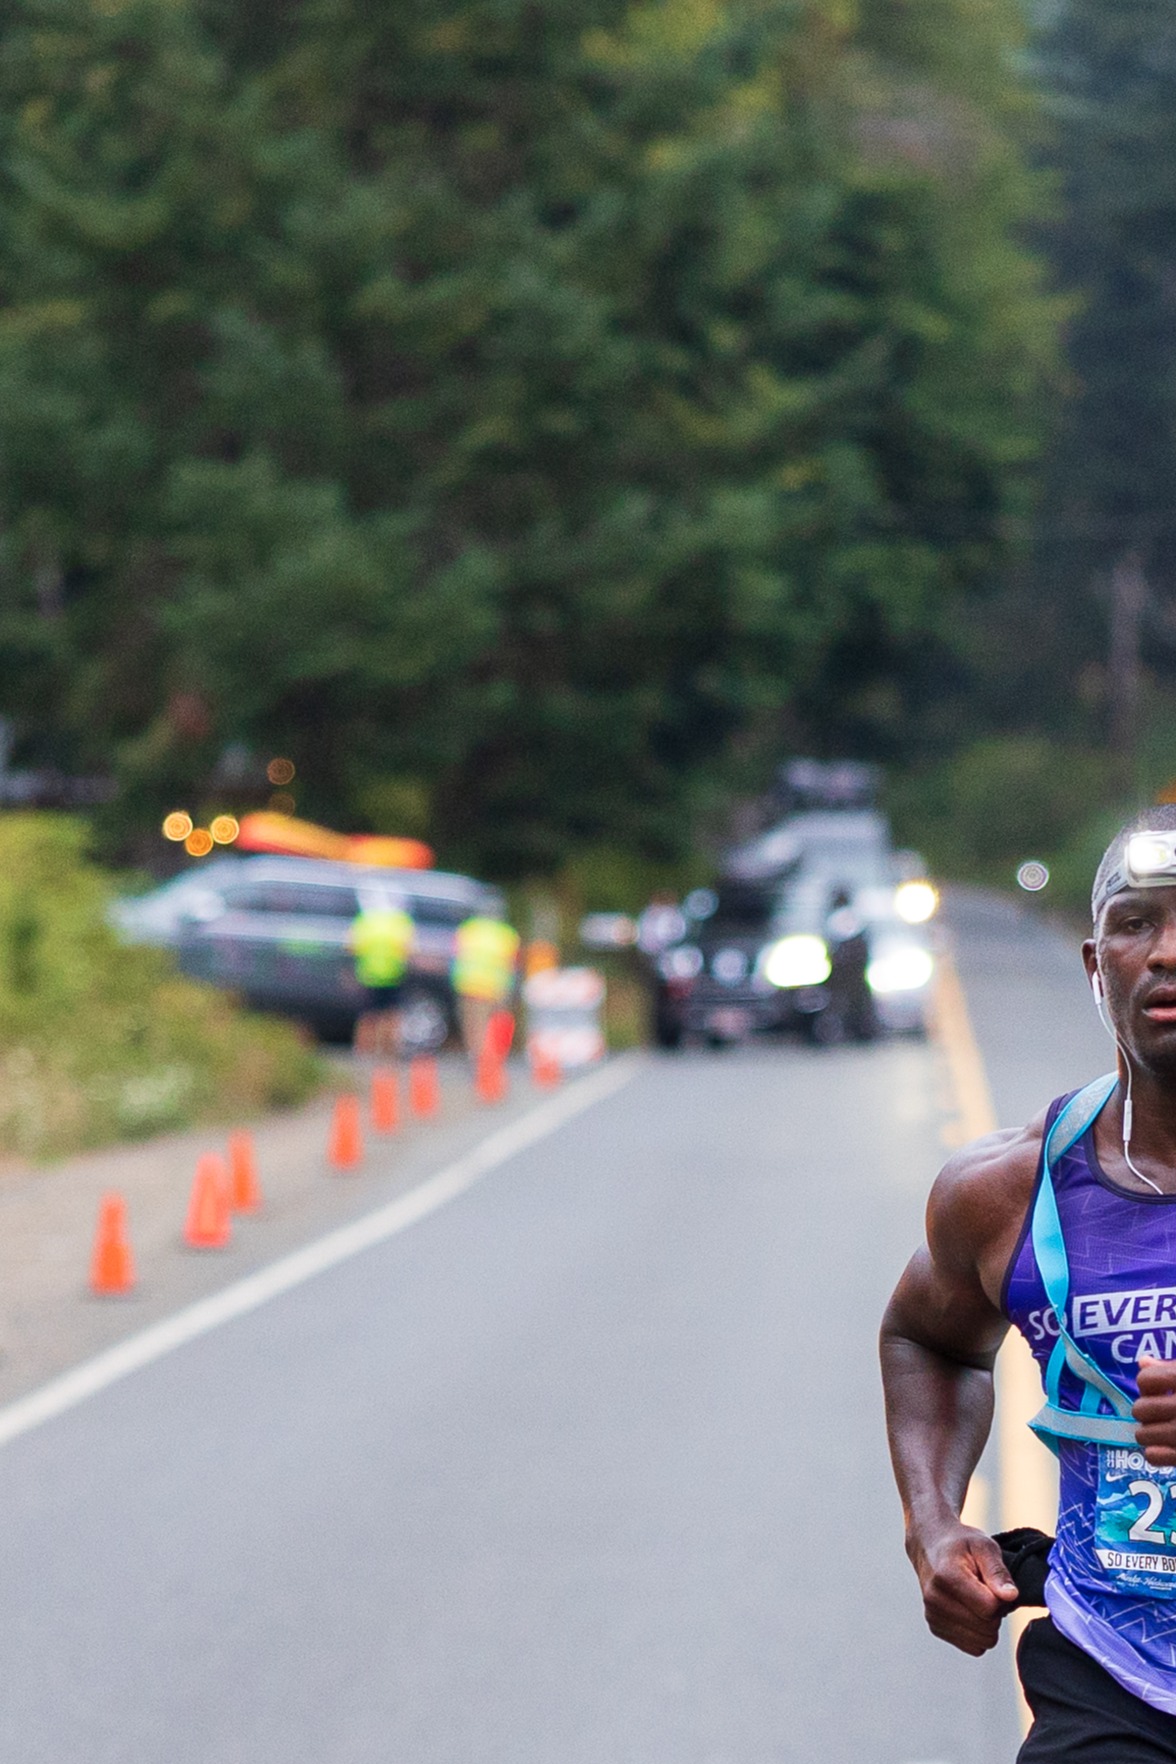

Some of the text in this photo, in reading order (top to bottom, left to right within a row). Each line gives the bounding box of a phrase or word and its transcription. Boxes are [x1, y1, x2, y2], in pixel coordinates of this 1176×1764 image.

[1028, 1307, 1068, 1341] SO
[1107, 1552, 1122, 1567] SO
[1126, 1556, 1158, 1571] EVERY
